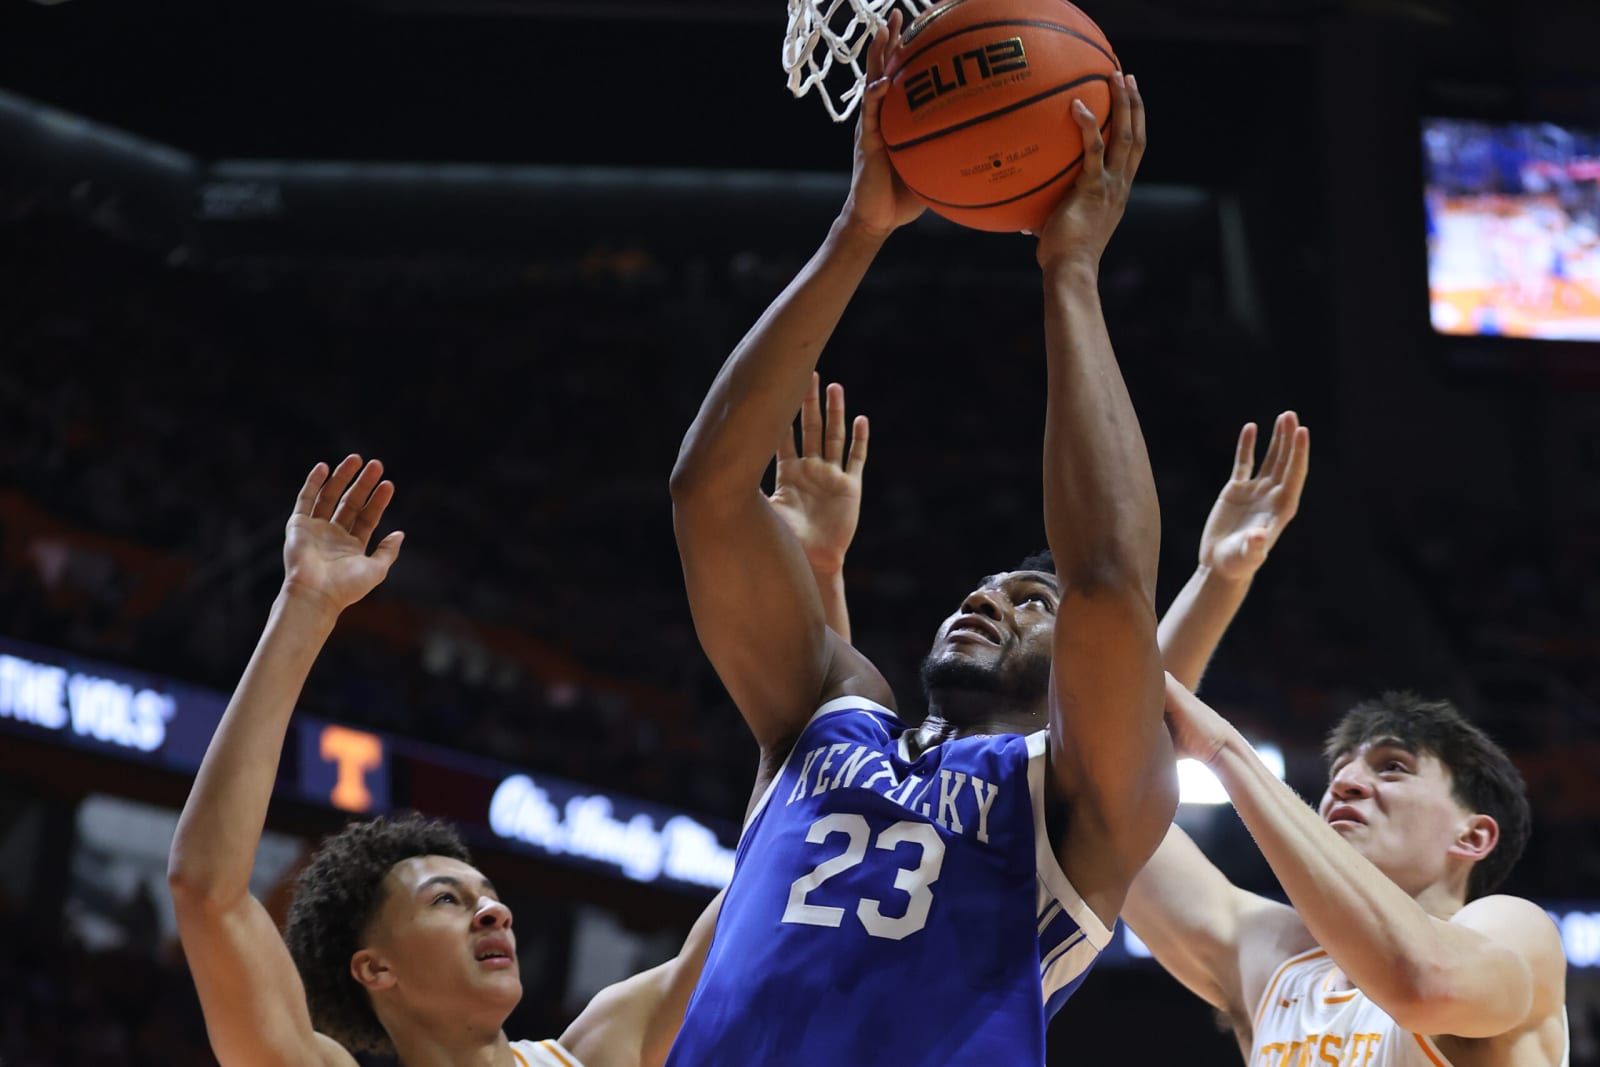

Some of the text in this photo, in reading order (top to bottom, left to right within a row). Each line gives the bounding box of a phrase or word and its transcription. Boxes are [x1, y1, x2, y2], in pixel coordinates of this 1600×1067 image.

[904, 37, 1027, 111] ELITE
[320, 724, 382, 813] T
[781, 813, 946, 940] 23
